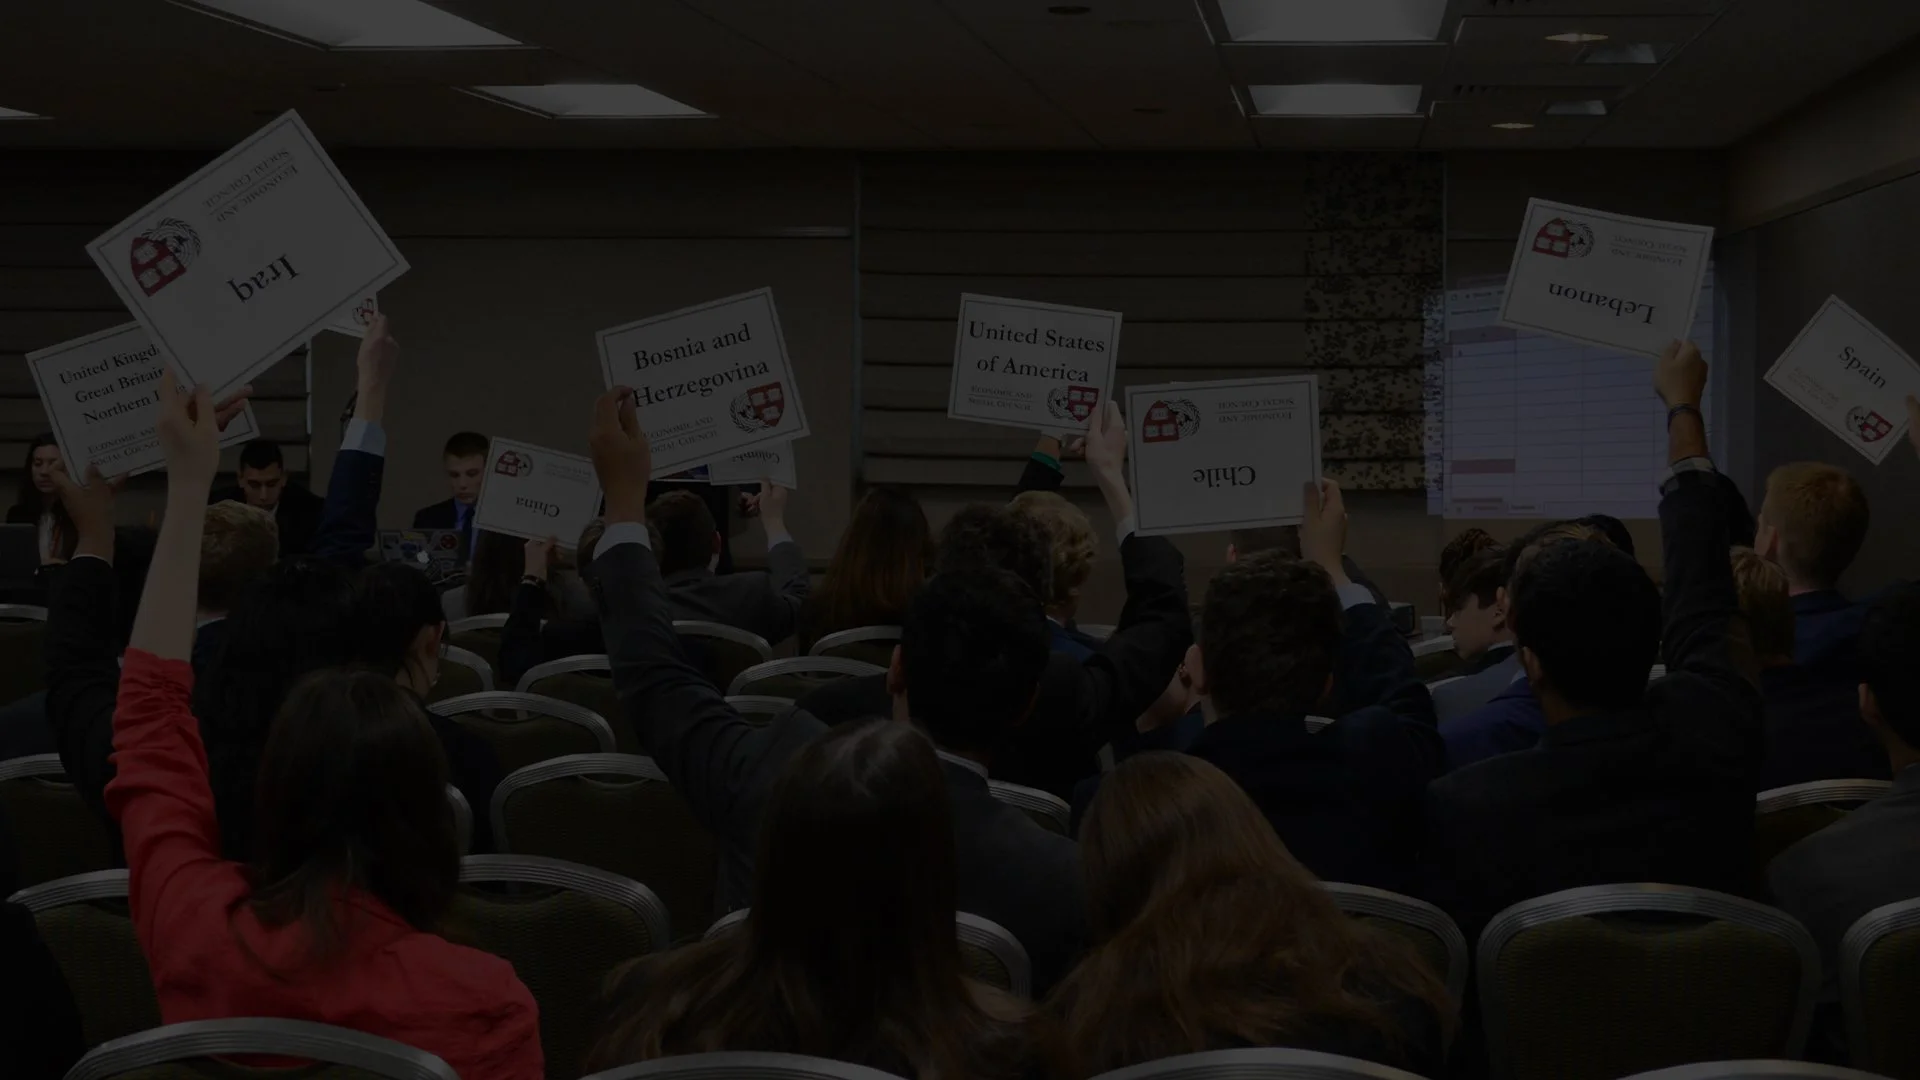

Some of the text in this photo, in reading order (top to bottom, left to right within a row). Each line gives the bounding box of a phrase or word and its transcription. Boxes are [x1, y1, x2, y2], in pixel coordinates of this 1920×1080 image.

[225, 253, 300, 303] Iraq
[1549, 283, 1657, 325] Lebanon
[633, 323, 752, 371] Bosnia and
[969, 320, 1106, 353] United States
[59, 343, 161, 386] United Kingd
[977, 355, 1089, 383] of America
[1838, 346, 1886, 389] Spain
[75, 382, 115, 405] Great
[633, 361, 770, 408] Herzegovina
[82, 395, 151, 425] Northern
[650, 442, 676, 454] OCIAL
[1193, 465, 1256, 488] Chile
[516, 496, 560, 518] China
